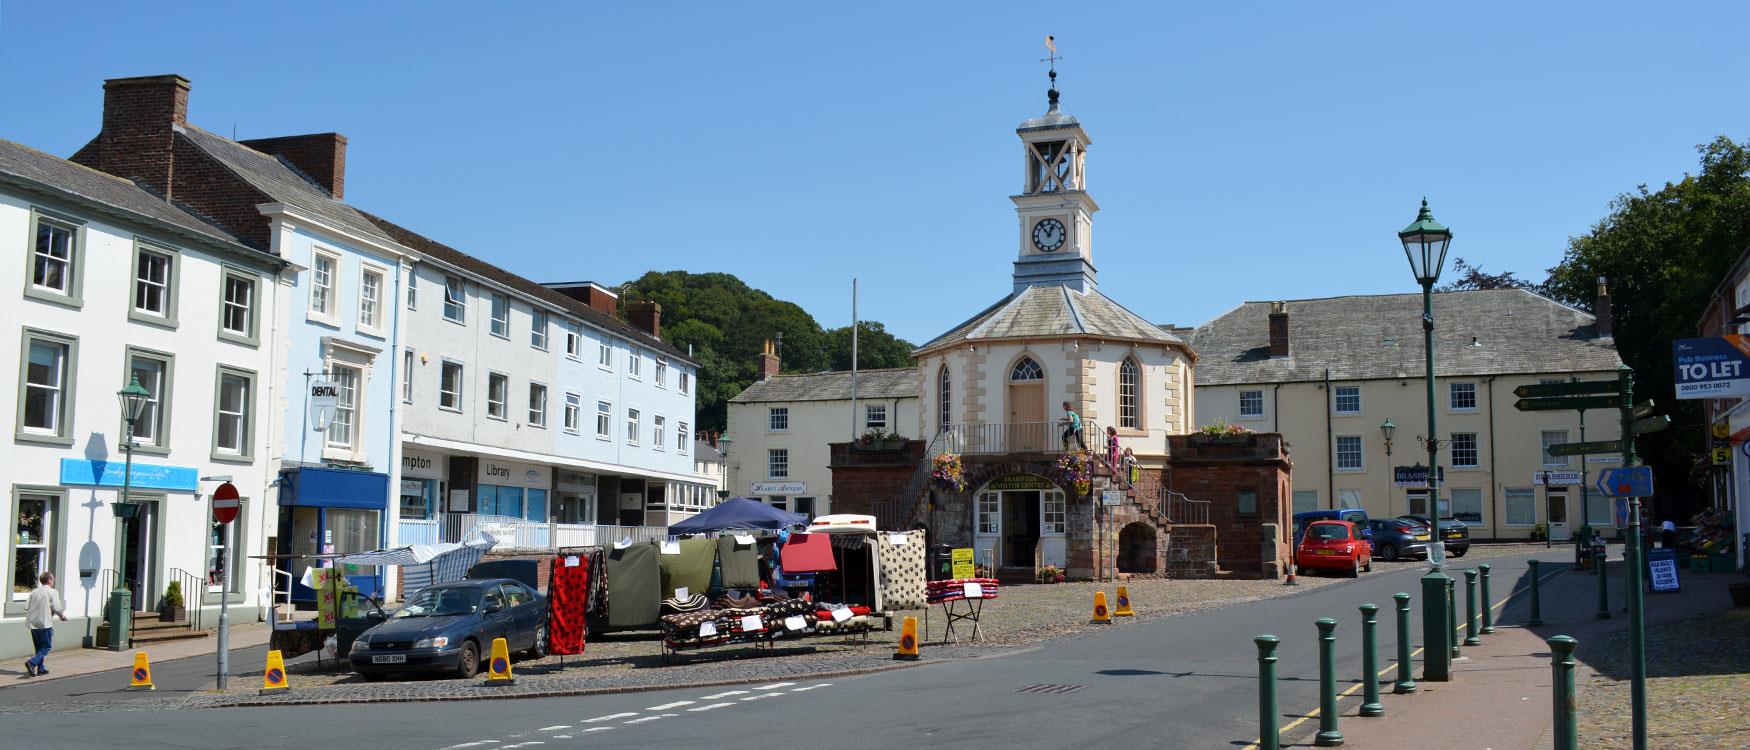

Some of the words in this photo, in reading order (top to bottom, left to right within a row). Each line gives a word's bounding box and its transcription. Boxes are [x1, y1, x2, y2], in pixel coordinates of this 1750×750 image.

[1695, 354, 1728, 362] Business
[1679, 363, 1708, 380] TO
[1711, 360, 1742, 378] LET
[312, 386, 337, 397] DENTAL
[1717, 451, 1727, 462] 5
[486, 463, 511, 480] Library
